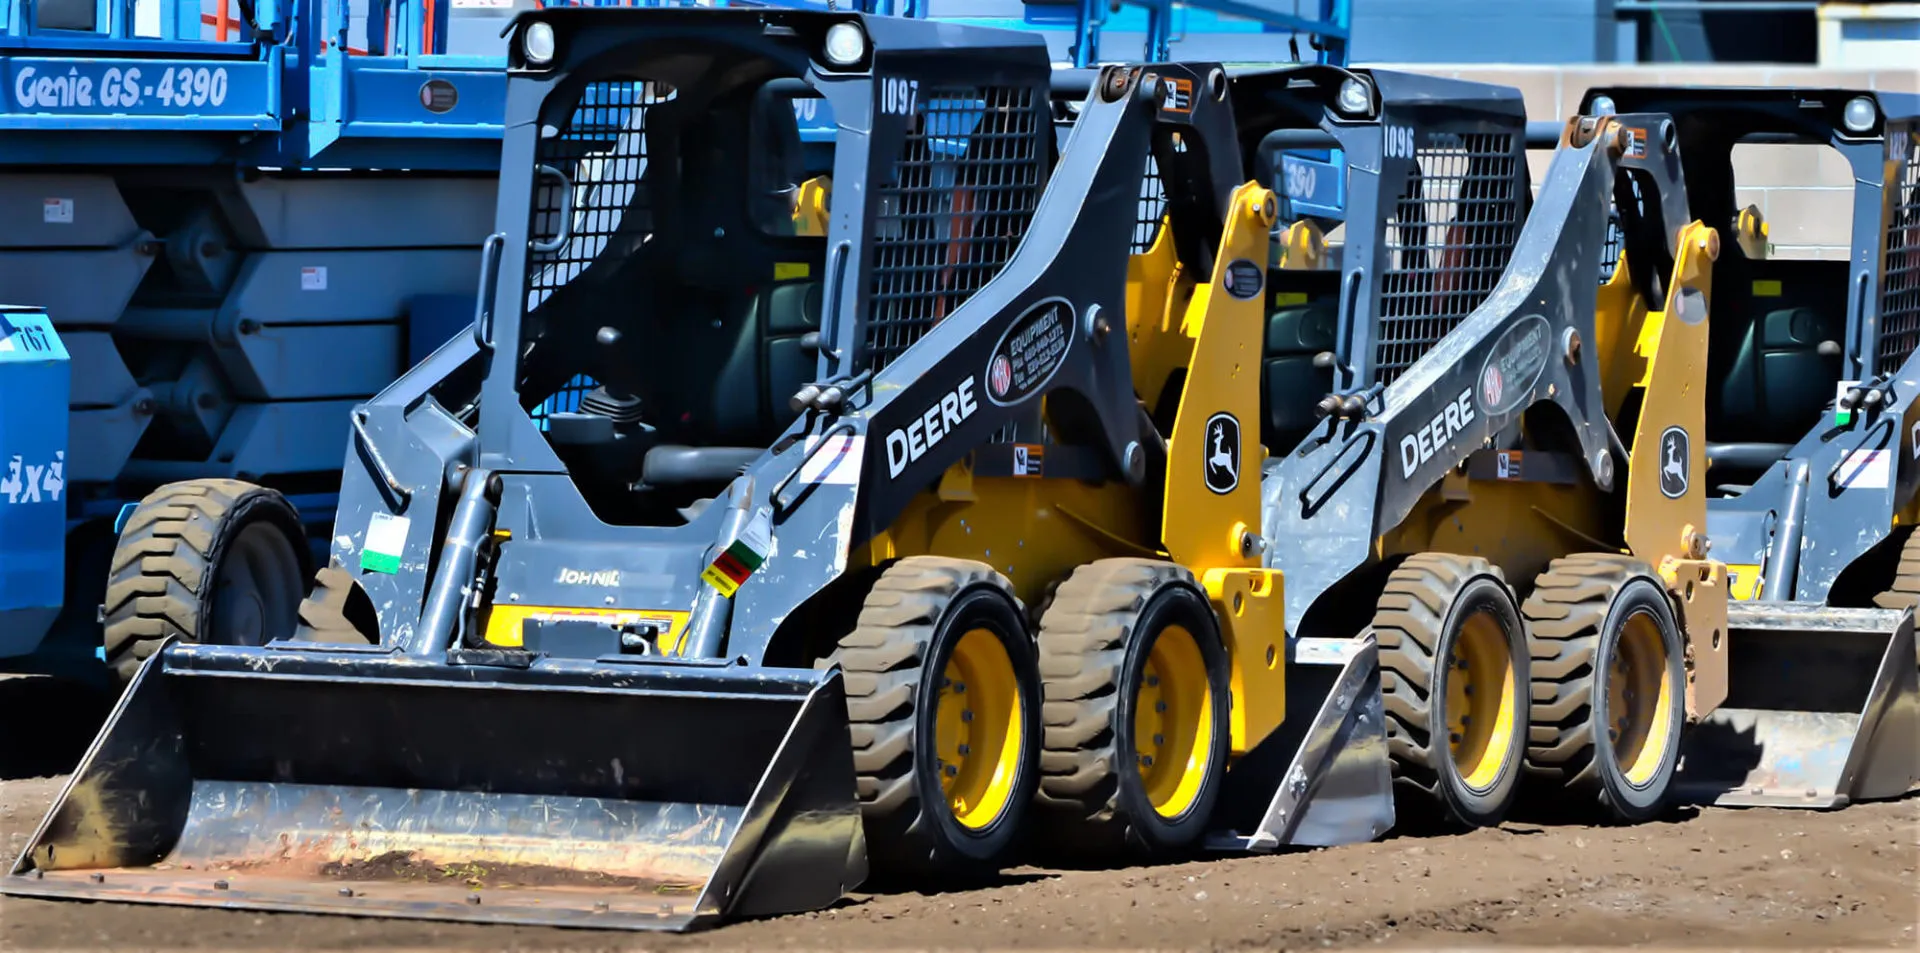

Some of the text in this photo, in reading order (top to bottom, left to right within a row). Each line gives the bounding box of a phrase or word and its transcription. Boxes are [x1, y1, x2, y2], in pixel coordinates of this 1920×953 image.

[15, 66, 95, 108] Genie
[881, 78, 919, 116] 1097
[1384, 125, 1415, 160] 1096
[1010, 304, 1060, 358] EQUIPMENT
[886, 375, 978, 480] DEERE
[1400, 387, 1475, 479] DEERE
